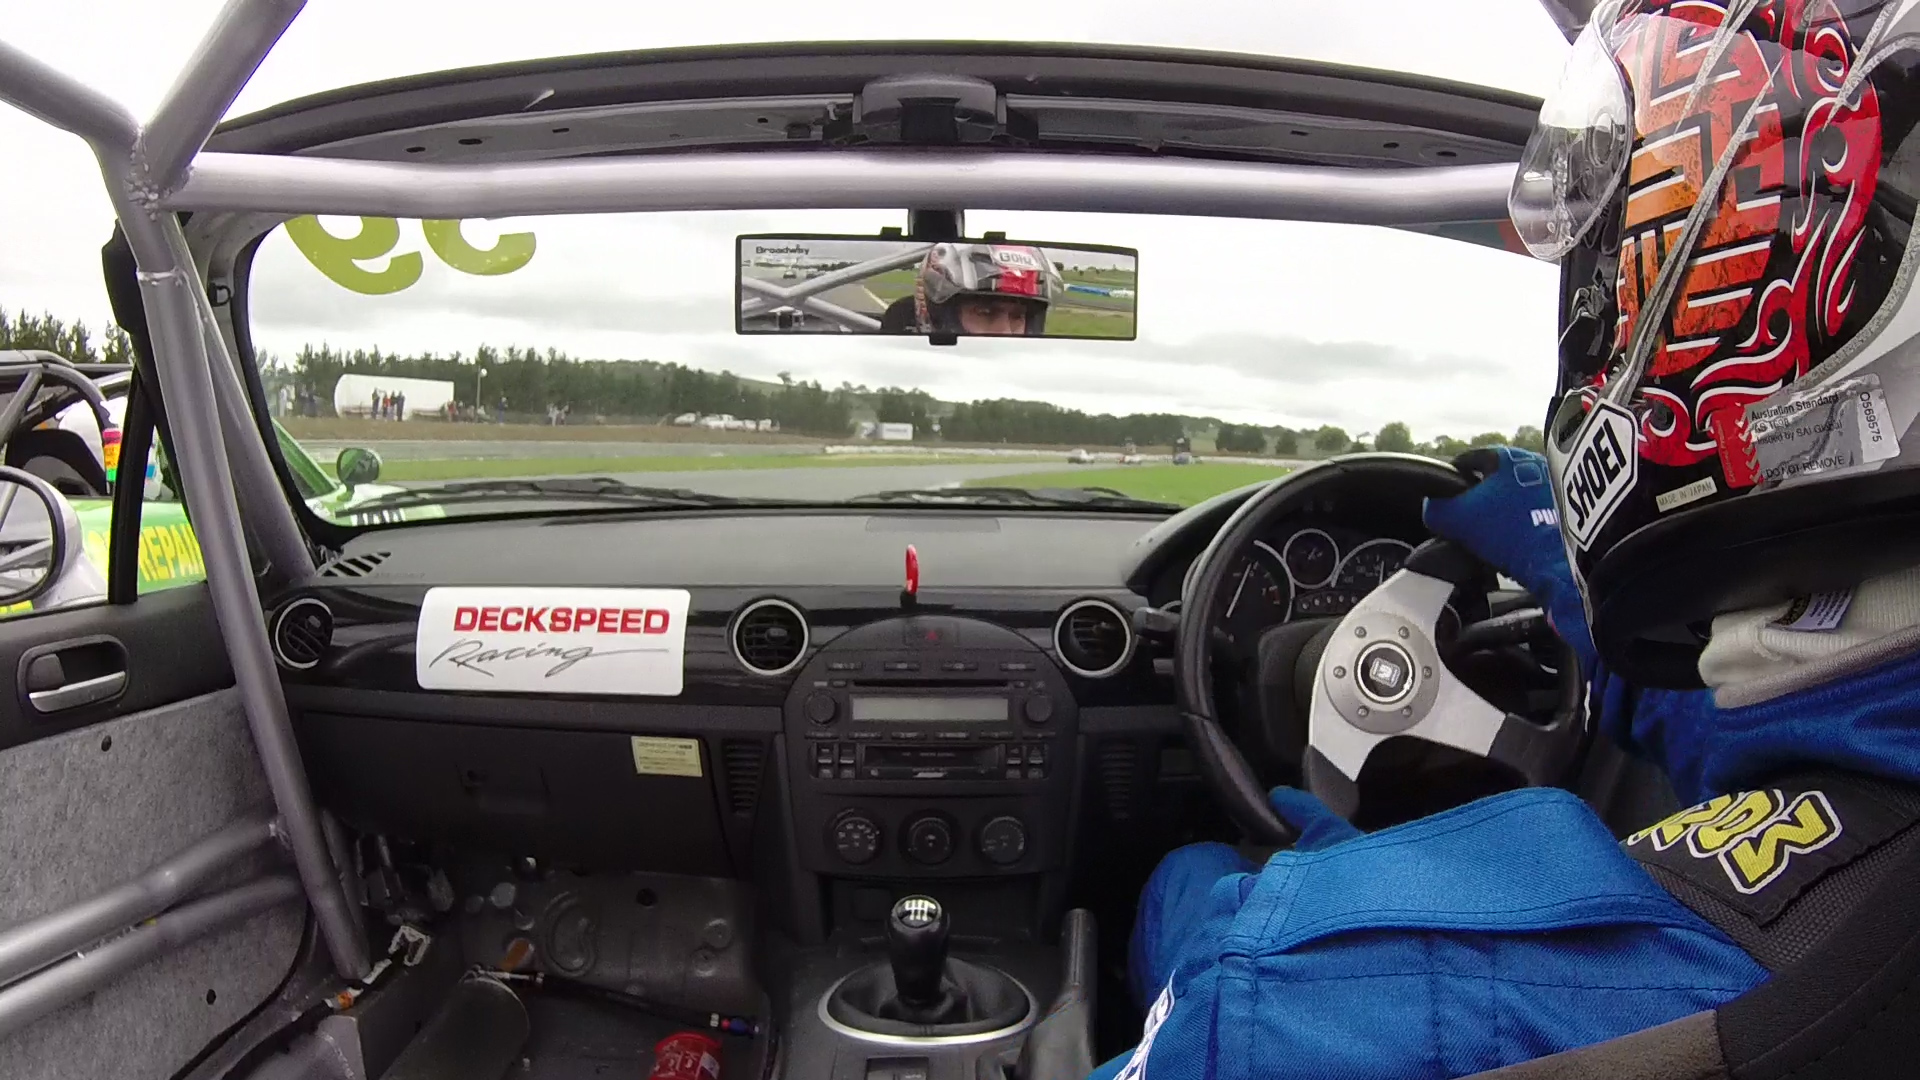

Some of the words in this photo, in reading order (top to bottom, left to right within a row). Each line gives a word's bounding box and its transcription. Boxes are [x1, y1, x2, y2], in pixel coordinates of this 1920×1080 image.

[1751, 404, 1795, 421] Australian
[1796, 392, 1839, 411] Standard
[1566, 418, 1627, 532] SHOEI
[1766, 467, 1780, 478] DO
[1802, 455, 1845, 471] REMOVE
[1658, 493, 1677, 506] MADE
[1679, 489, 1687, 499] IN
[1690, 480, 1713, 497] JAPAN
[1531, 508, 1558, 527] PU
[138, 524, 206, 582] REPAI
[453, 605, 671, 634] DECKSPEED
[428, 638, 669, 679] Racing
